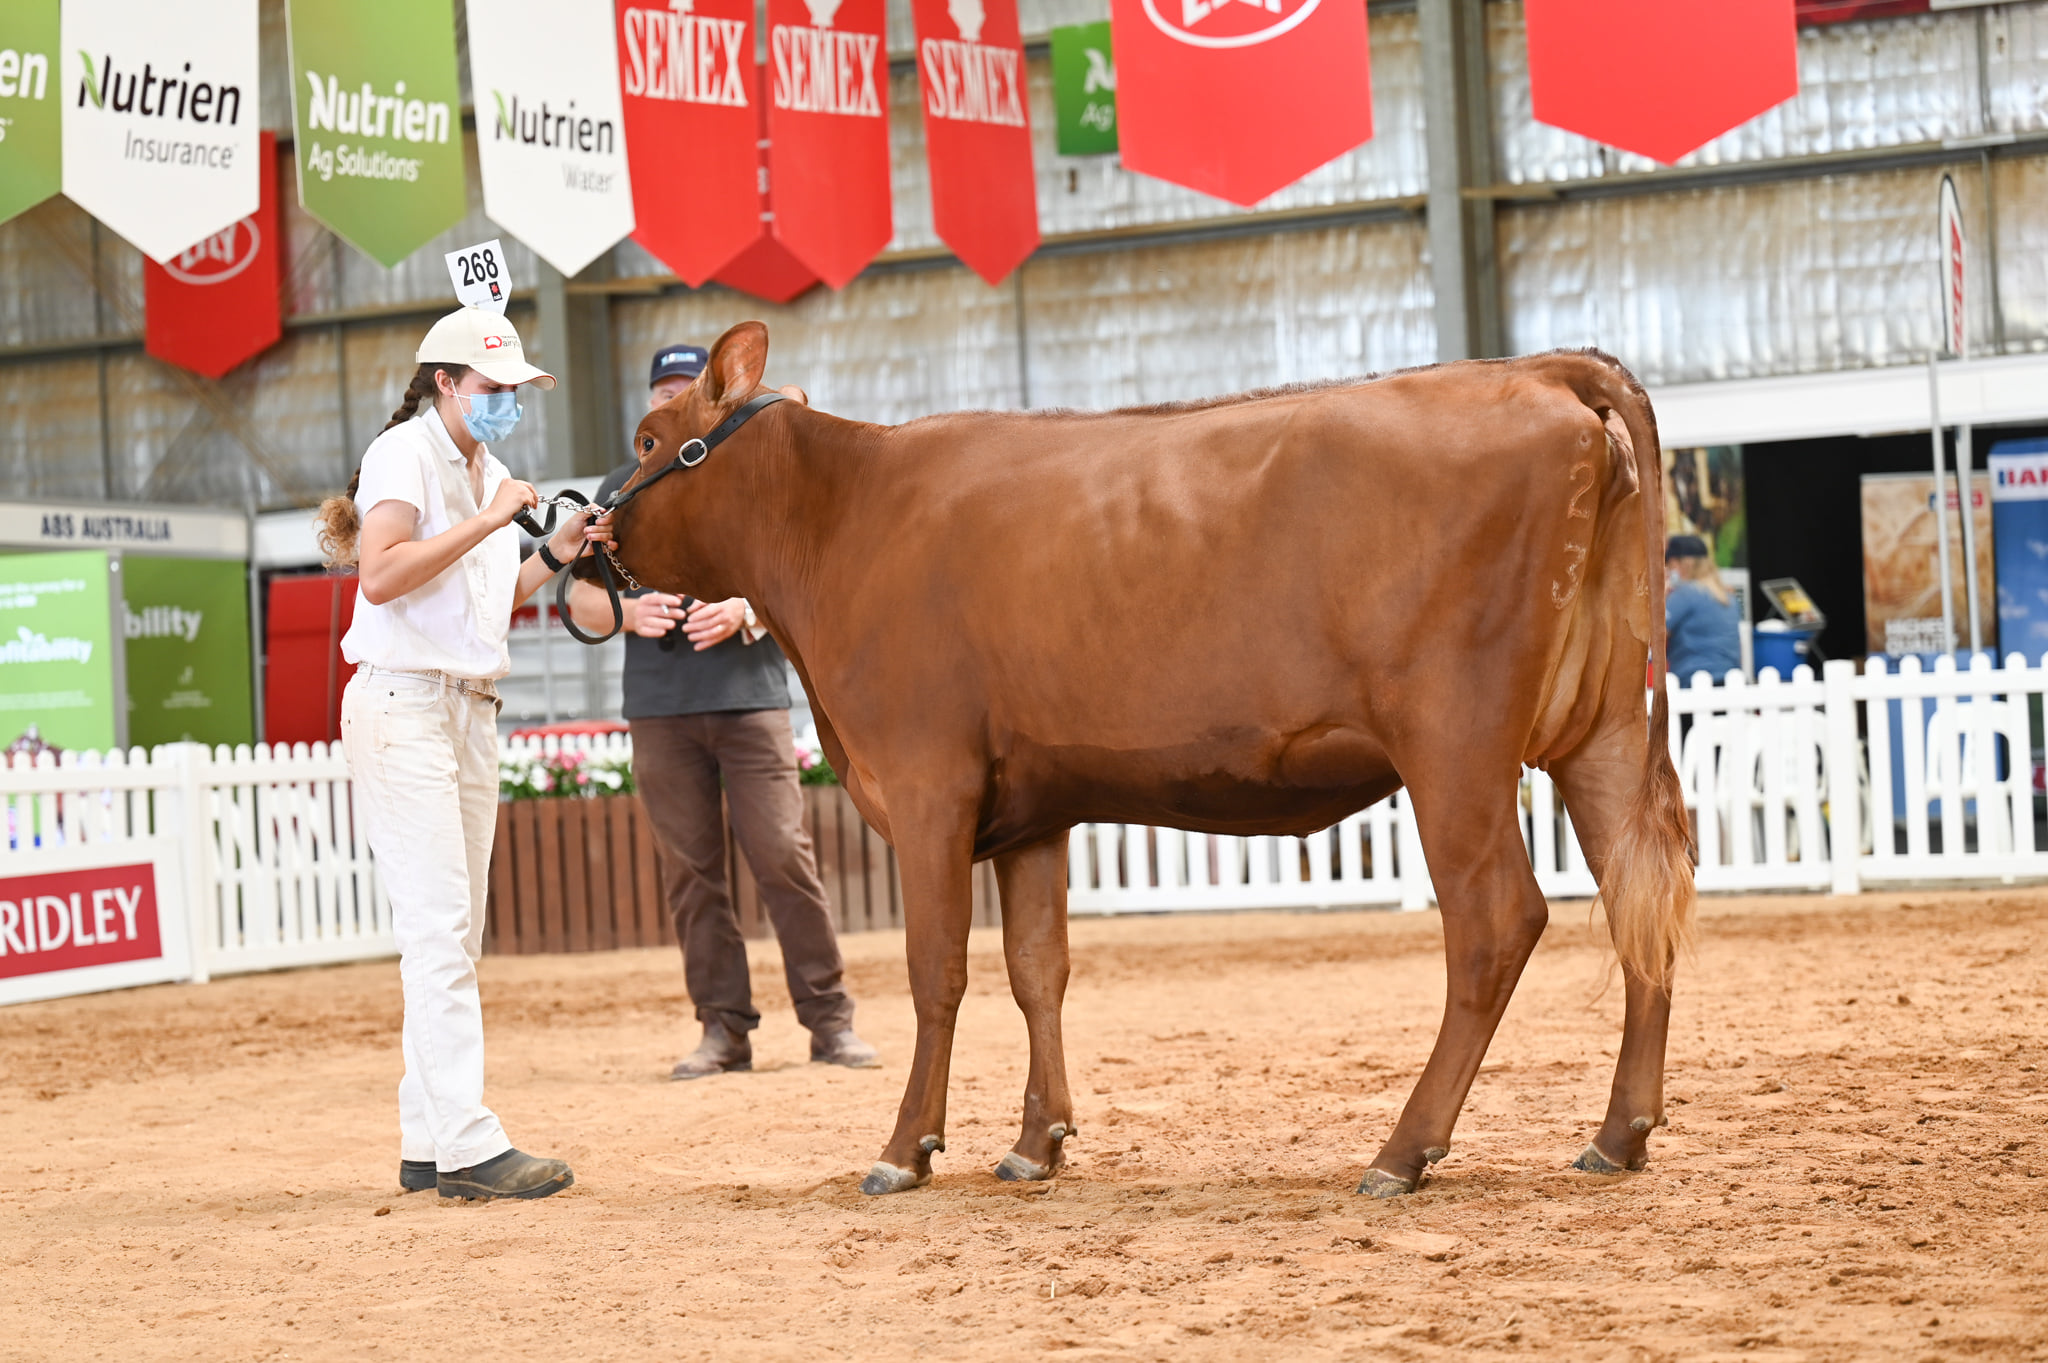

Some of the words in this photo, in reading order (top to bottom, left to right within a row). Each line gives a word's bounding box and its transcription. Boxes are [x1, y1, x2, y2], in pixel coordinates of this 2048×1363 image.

[78, 49, 240, 125] Nutrien
[623, 7, 748, 107] SEMEX
[772, 23, 882, 117] SEMEX
[921, 37, 1026, 128] SEMEX
[306, 70, 449, 144] Nutrien
[492, 88, 614, 154] Nutrien
[124, 130, 234, 169] Insurance
[308, 142, 333, 181] Ag
[562, 162, 613, 193] Water
[458, 249, 498, 286] 268
[41, 514, 75, 538] ABS
[81, 516, 172, 541] AUSTRALIA
[124, 605, 203, 642] bility
[0, 885, 142, 957] RIDLEY
